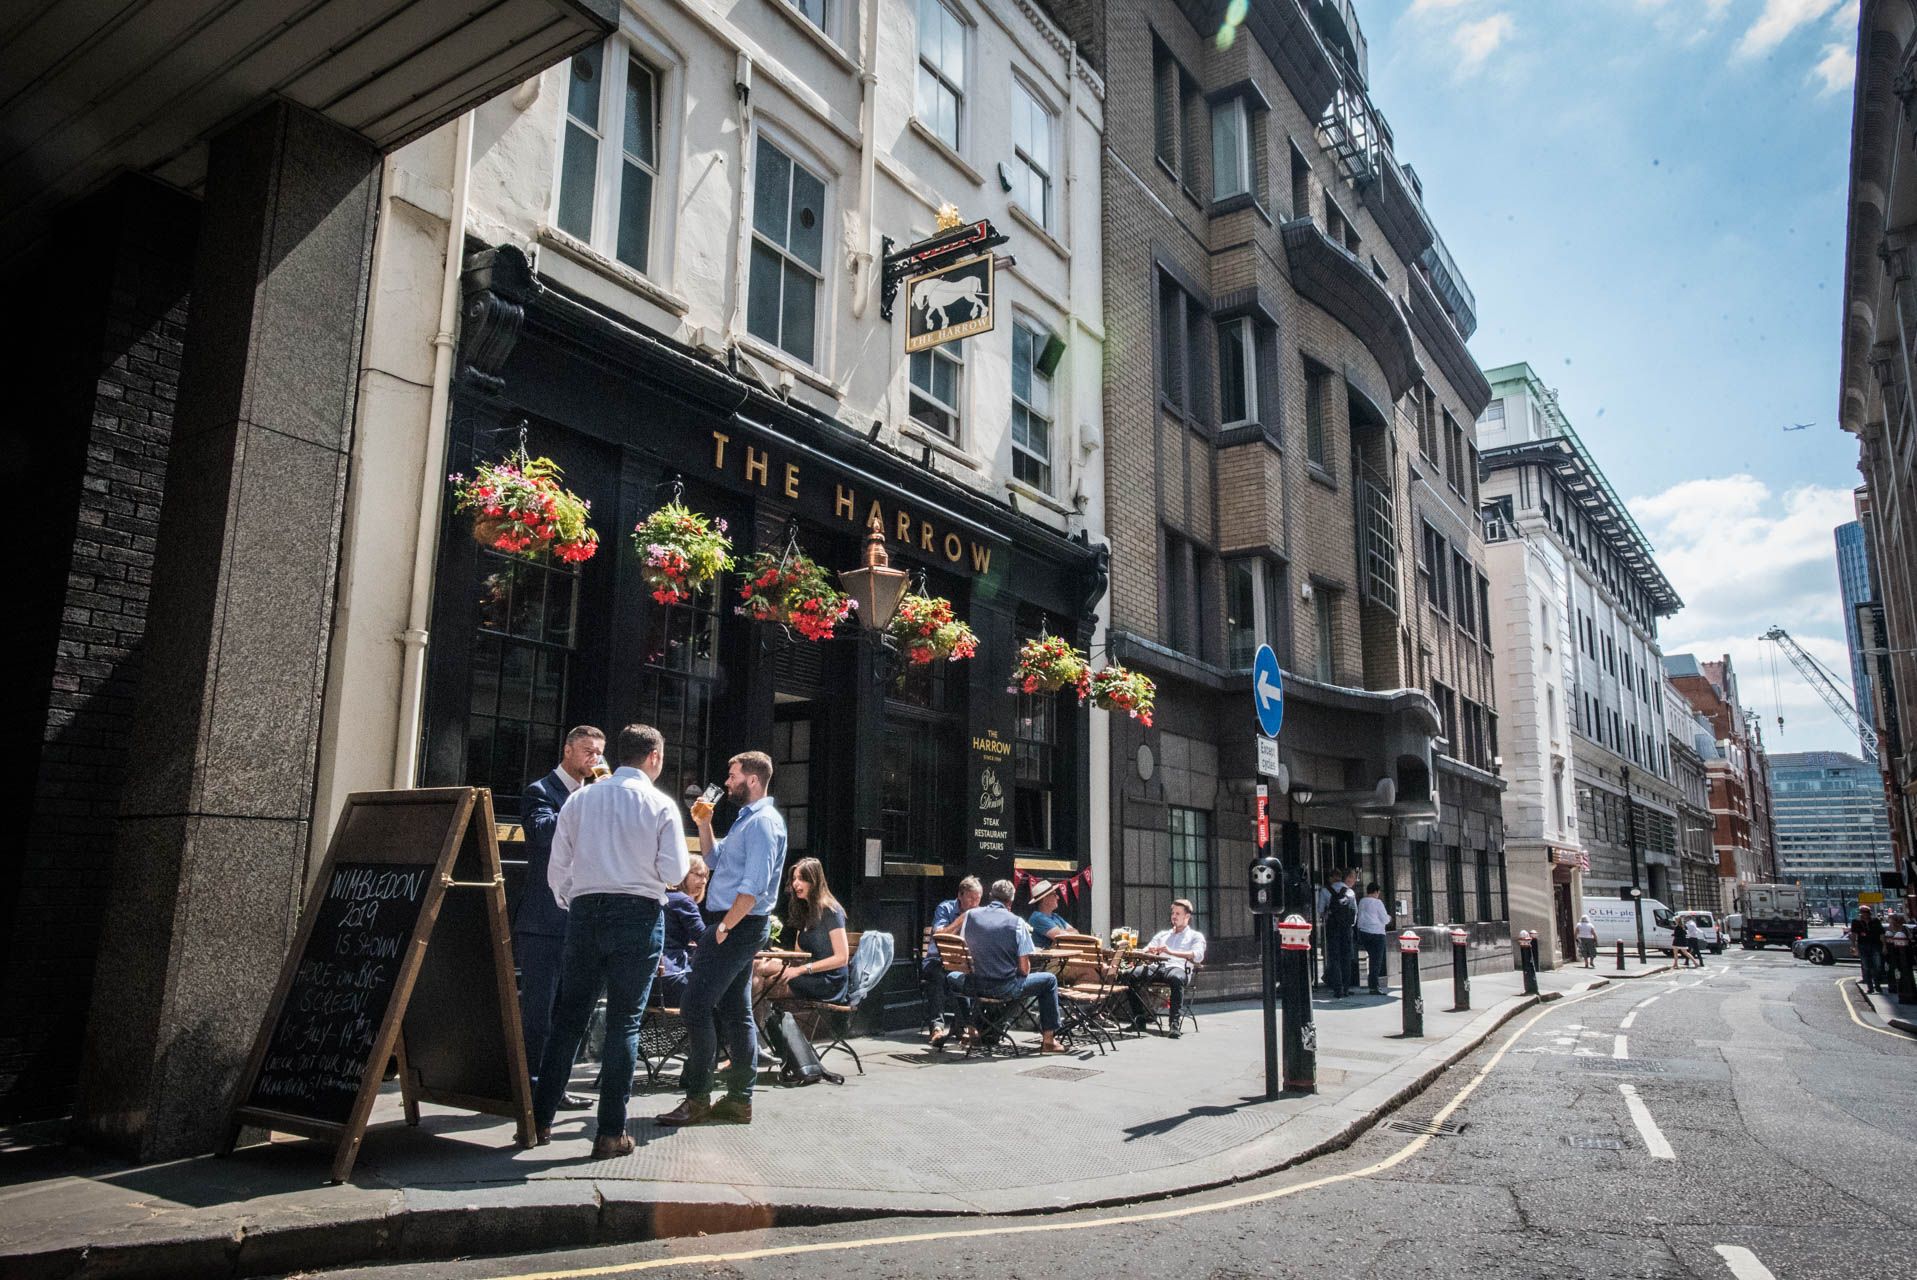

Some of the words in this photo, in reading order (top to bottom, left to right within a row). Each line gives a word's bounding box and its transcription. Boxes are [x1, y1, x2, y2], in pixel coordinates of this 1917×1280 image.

[911, 333, 933, 345] THE
[939, 318, 989, 339] HARROW
[713, 431, 799, 499] THE
[835, 484, 991, 575] HARROW
[987, 730, 998, 738] THE
[973, 737, 1011, 755] HARROW
[1261, 742, 1276, 759] Except
[1262, 759, 1276, 771] cycles
[983, 818, 999, 826] STEAK
[974, 829, 1007, 839] RESTAURANT
[979, 842, 1004, 850] UPSTAIRS
[331, 869, 424, 901] WIMBLEDON
[338, 900, 378, 930] 2019
[335, 933, 351, 954] IS
[355, 931, 403, 958] SHOWN
[354, 960, 385, 989] BIG
